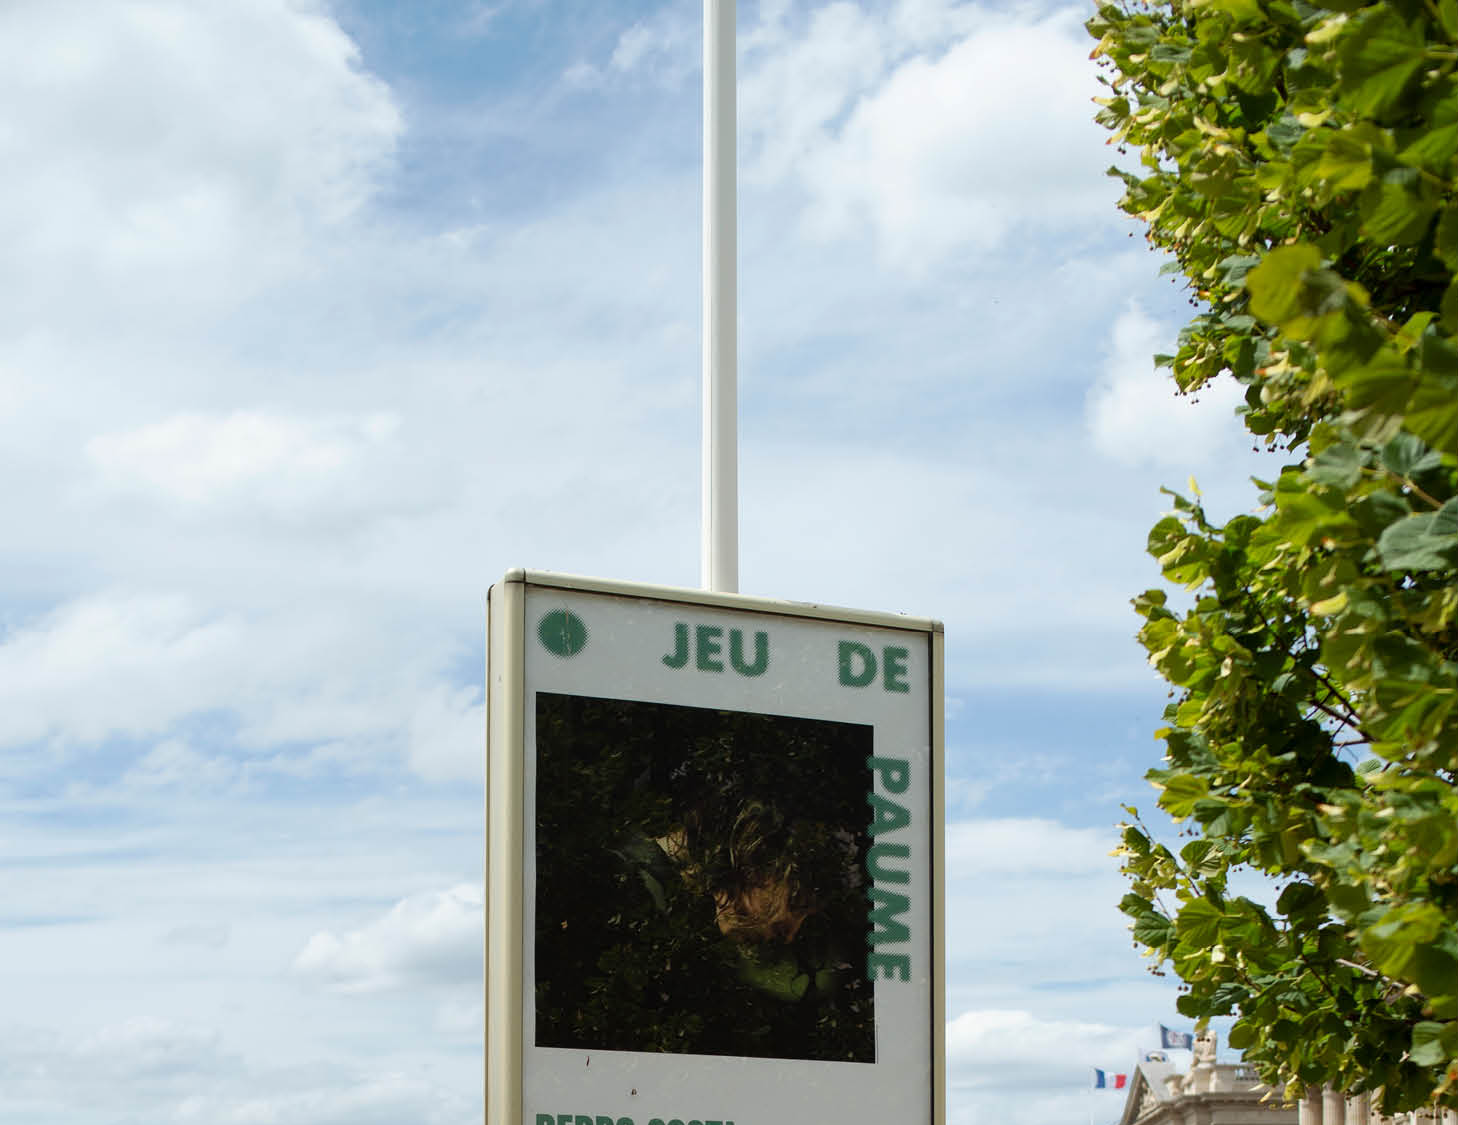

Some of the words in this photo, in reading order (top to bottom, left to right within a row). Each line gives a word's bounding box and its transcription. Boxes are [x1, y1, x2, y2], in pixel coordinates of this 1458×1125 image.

[662, 623, 769, 677] JEU
[838, 640, 910, 694] DE
[865, 754, 911, 983] PAUME
